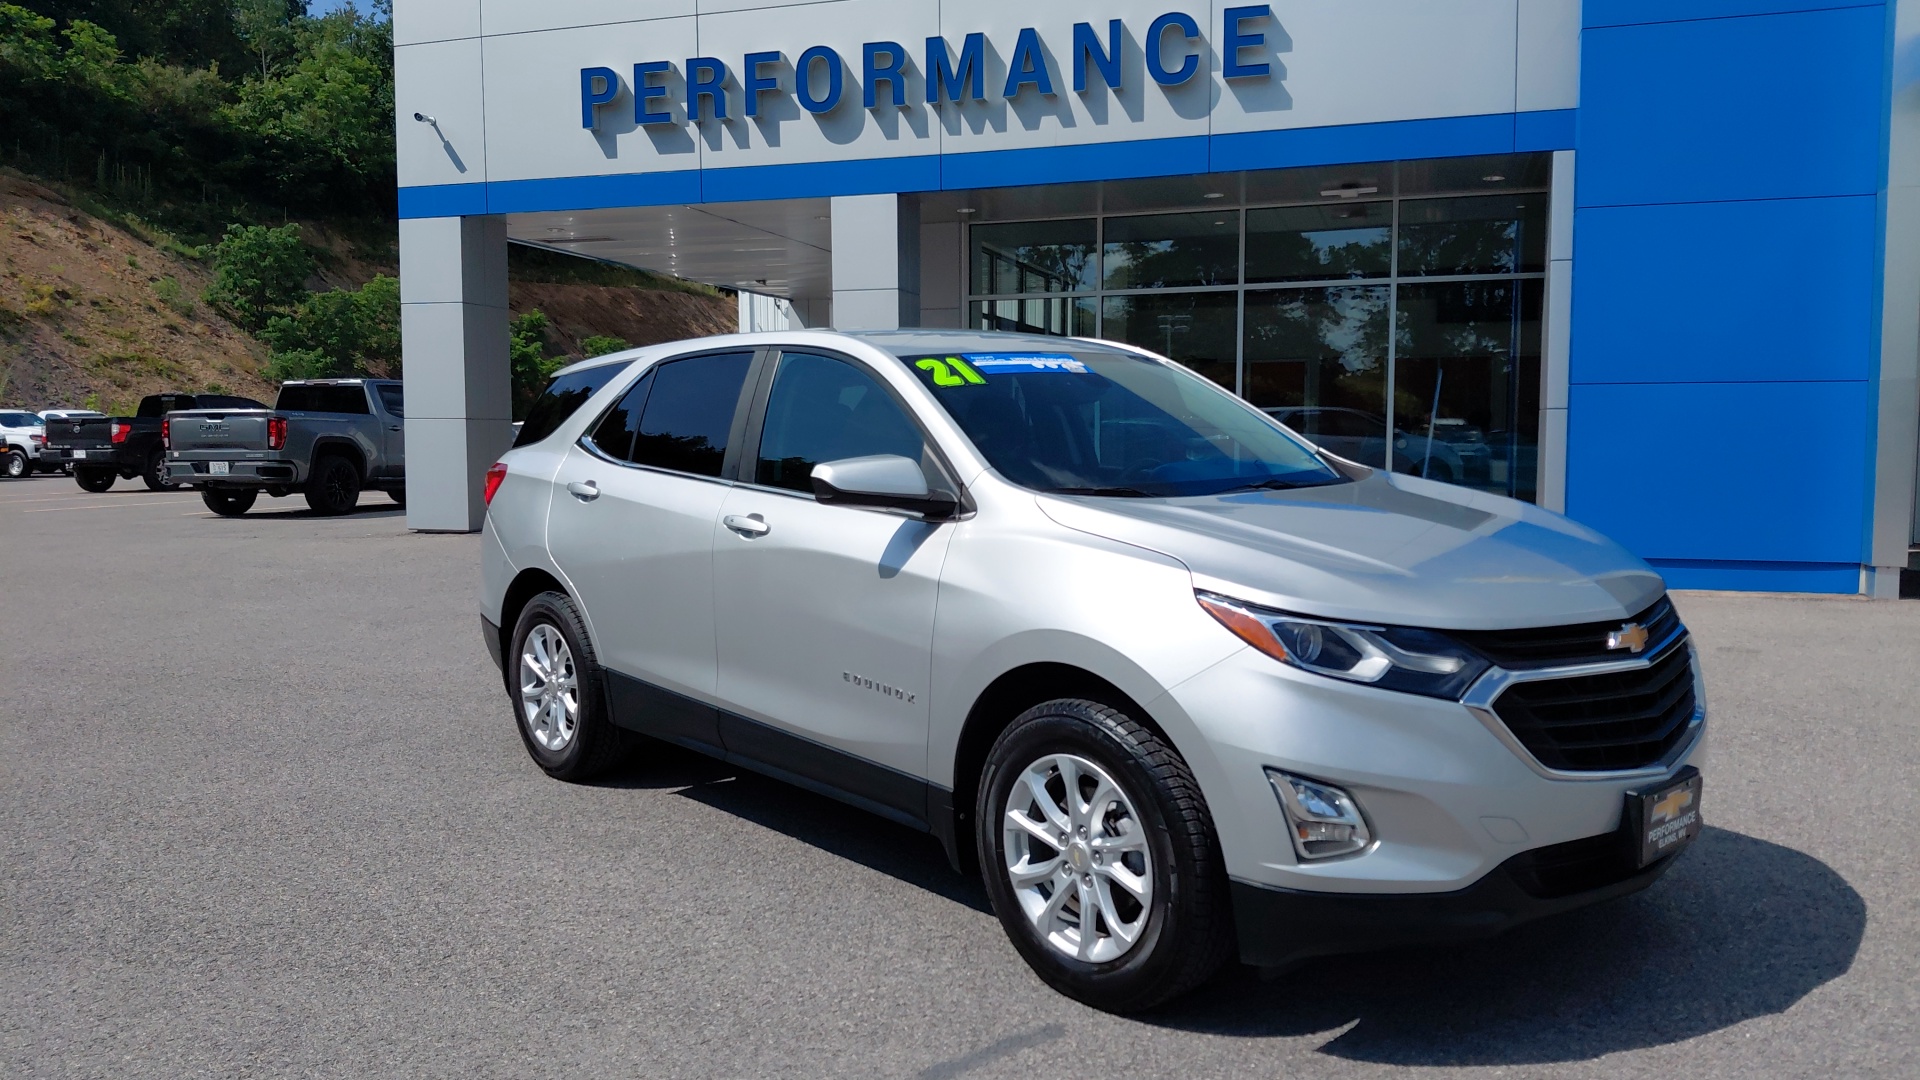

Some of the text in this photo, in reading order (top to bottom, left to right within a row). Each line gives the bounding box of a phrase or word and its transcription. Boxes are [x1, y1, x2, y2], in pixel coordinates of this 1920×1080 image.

[580, 5, 1272, 129] PERFORMANCE
[914, 356, 988, 388] 21
[842, 670, 916, 705] EQUINOX
[1648, 810, 1696, 844] PERFORMANCE
